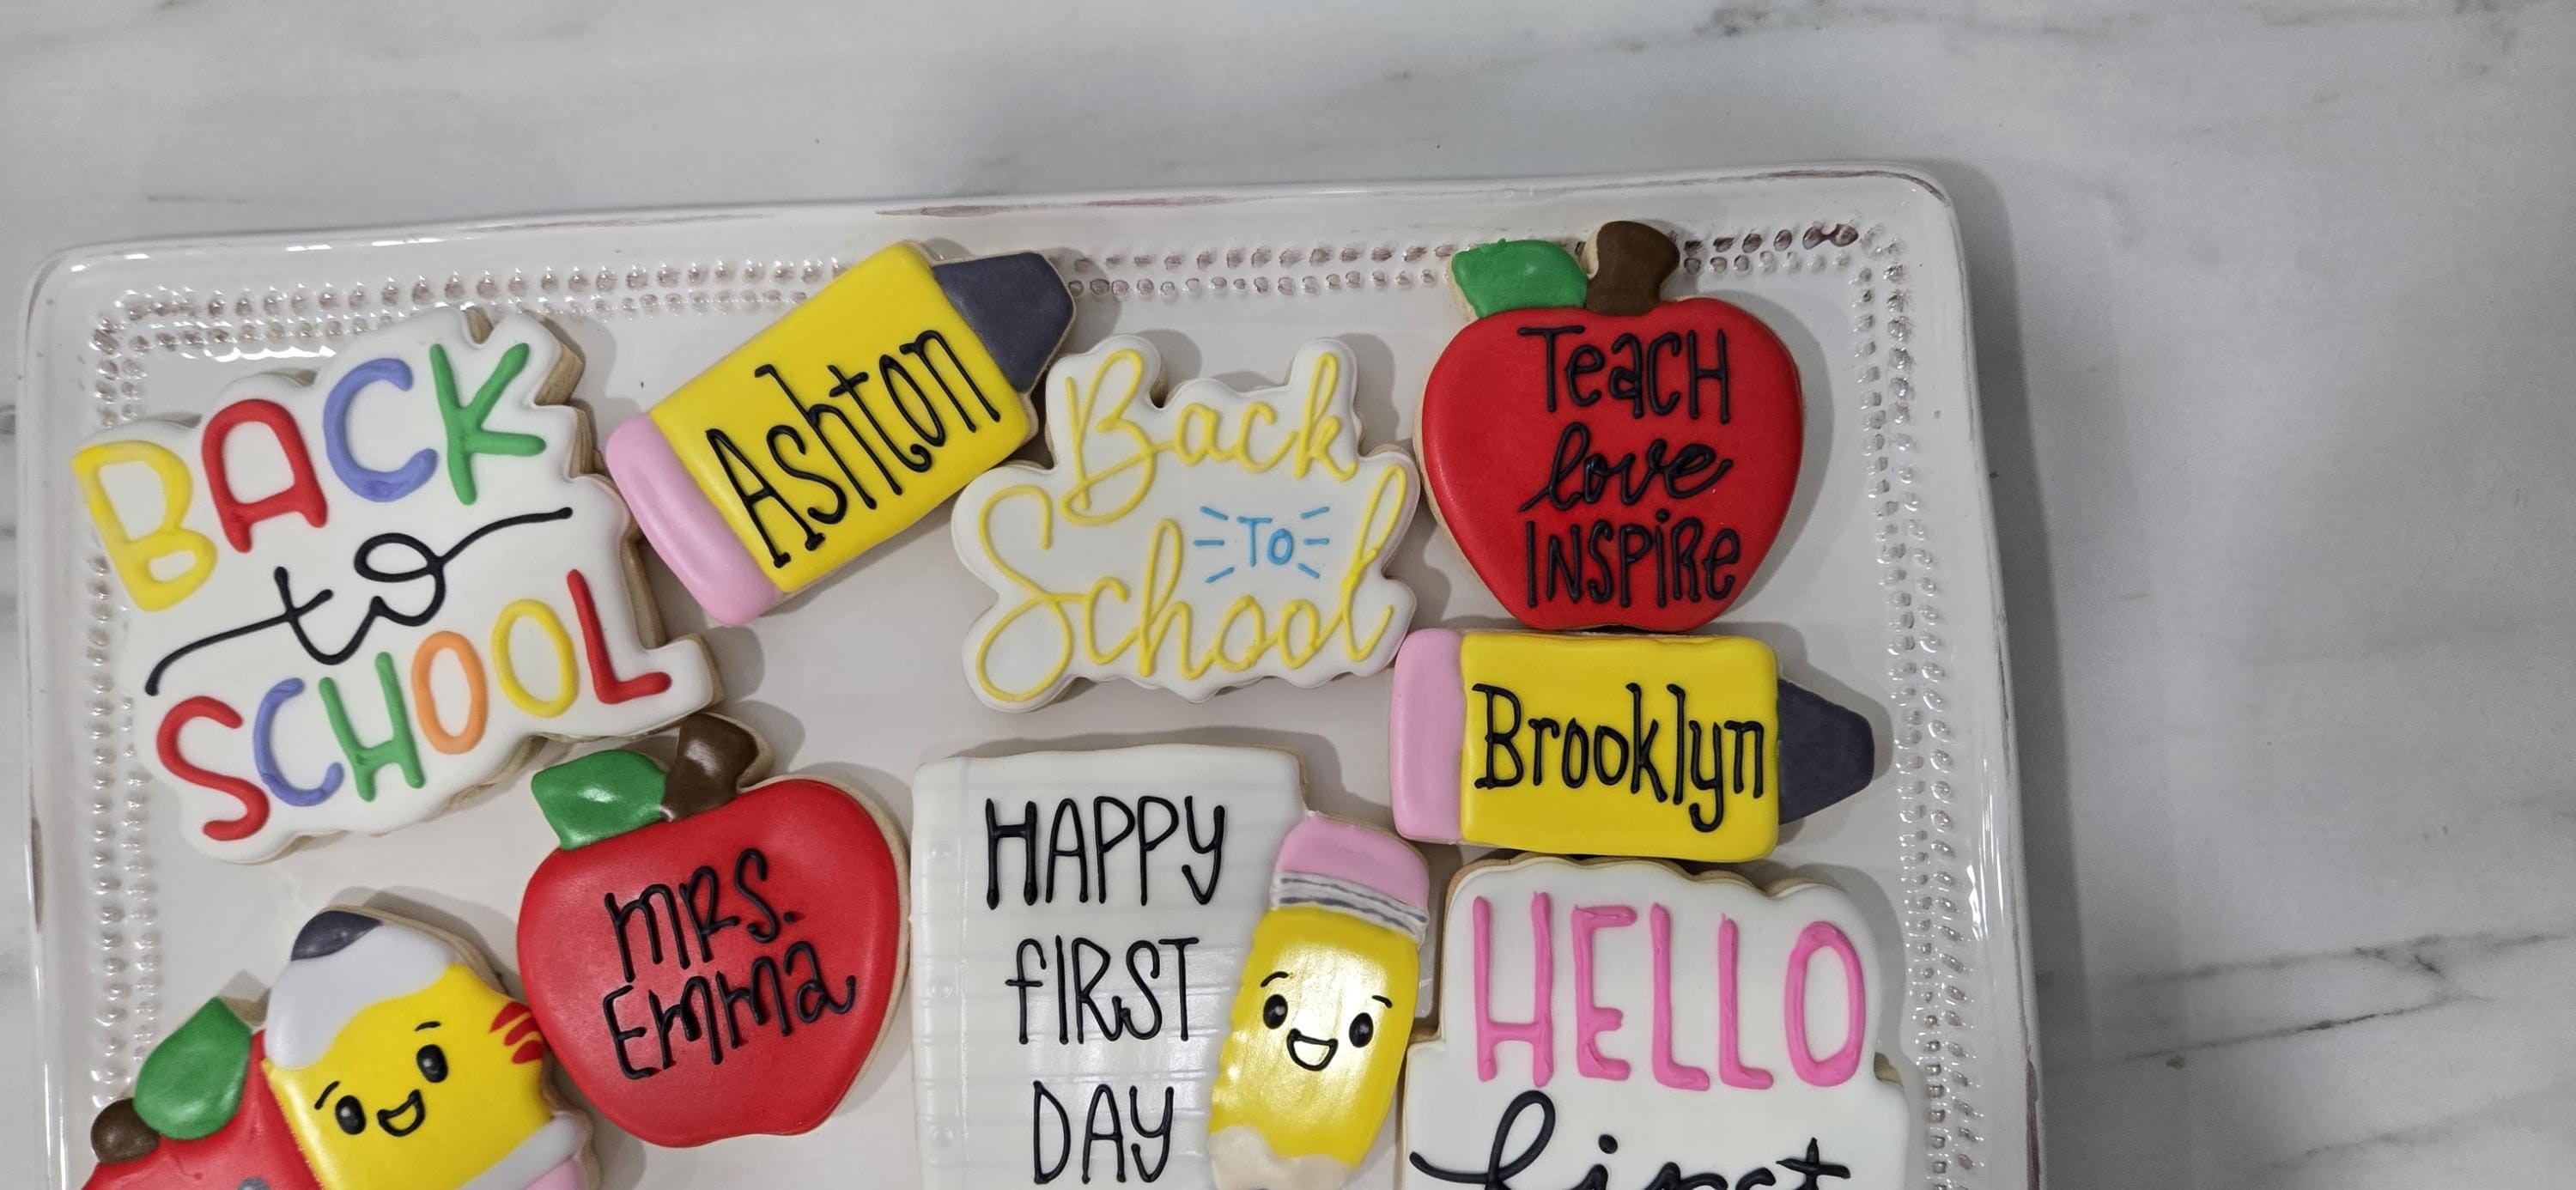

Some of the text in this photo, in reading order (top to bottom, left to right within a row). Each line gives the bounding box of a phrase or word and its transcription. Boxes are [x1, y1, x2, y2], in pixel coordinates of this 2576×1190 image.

[70, 343, 547, 611] BACK
[705, 329, 1001, 569] Ashton
[1059, 348, 1358, 528] Back
[1517, 422, 1734, 513] love
[144, 507, 574, 697] to
[975, 464, 1408, 702] School
[155, 569, 672, 841] SCHOOL
[1472, 683, 1765, 833] Brooklyn
[1472, 891, 1866, 1091] HELLO
